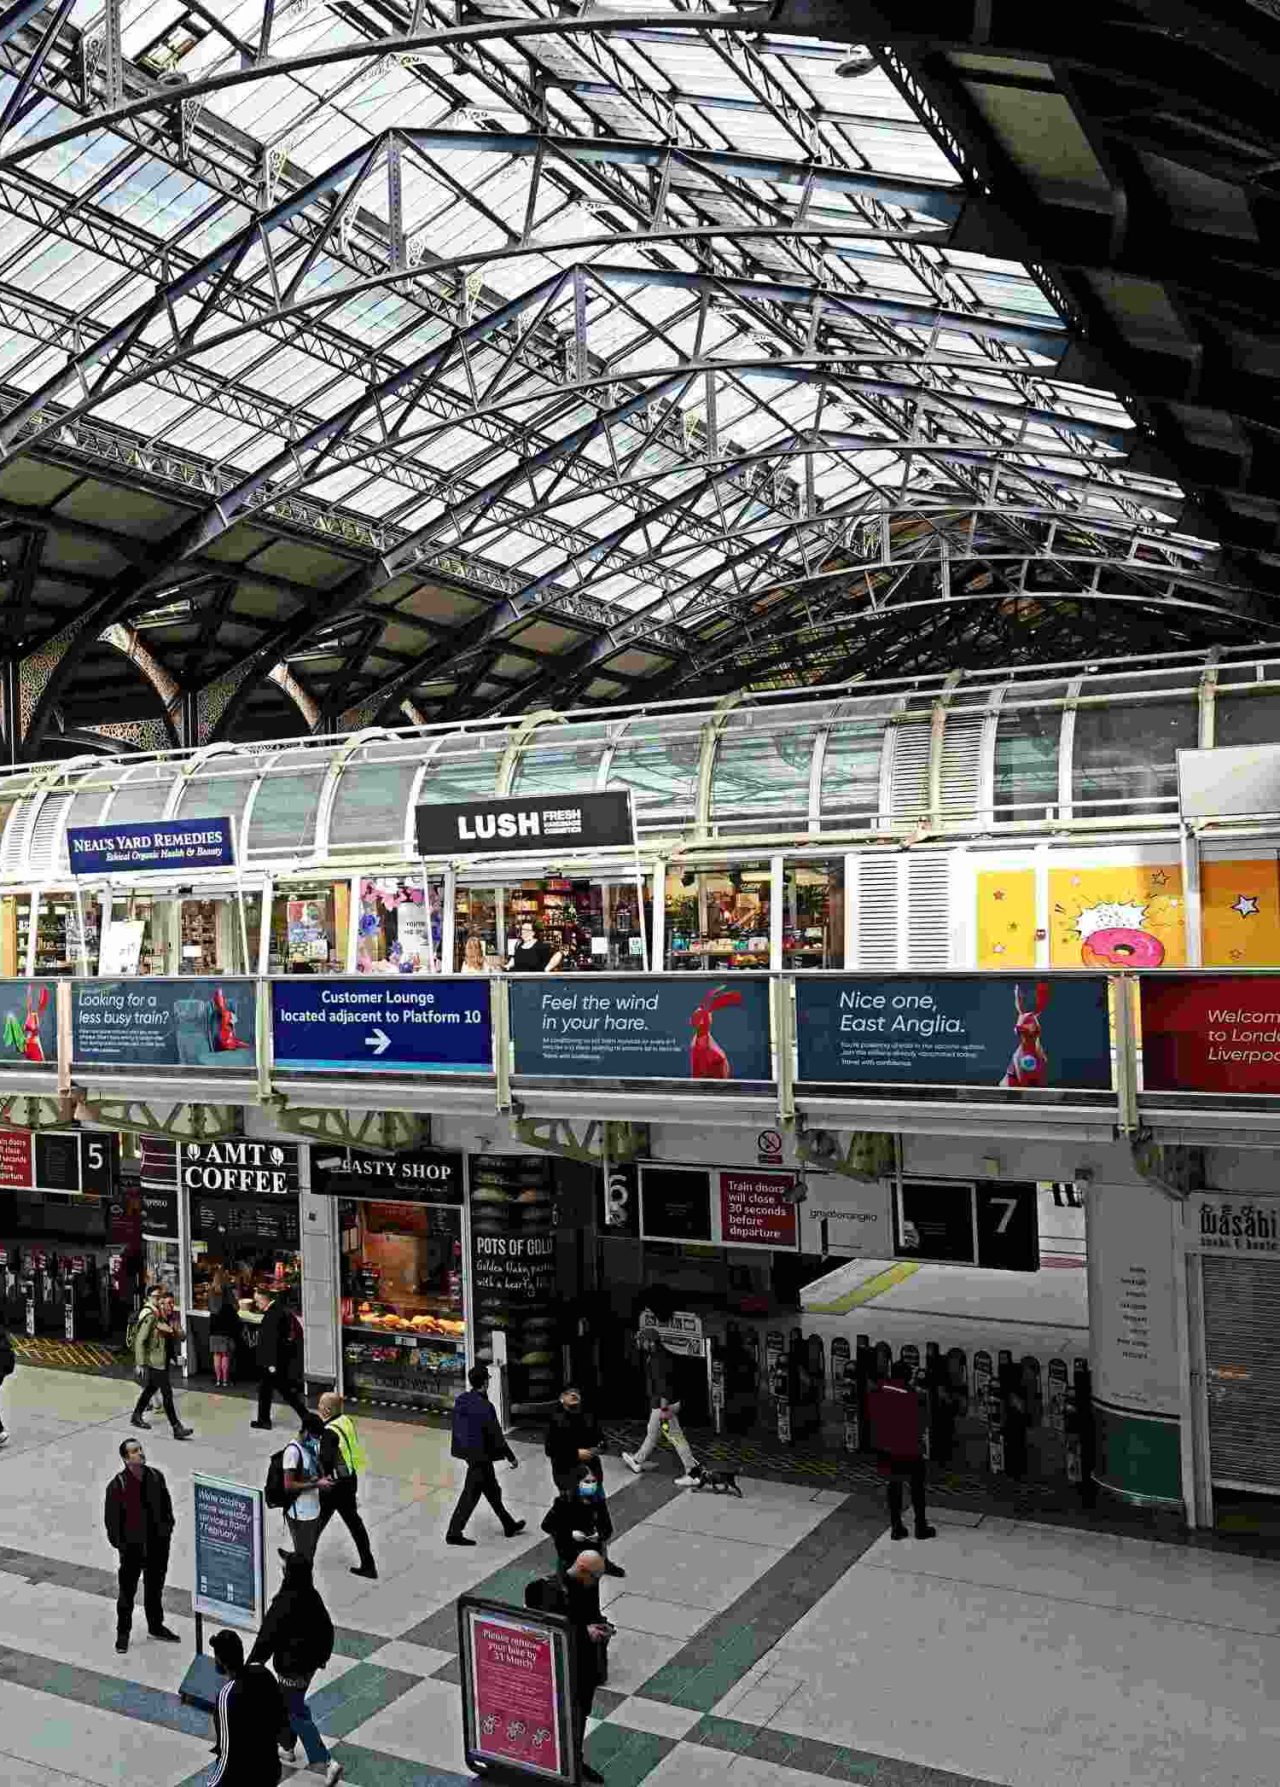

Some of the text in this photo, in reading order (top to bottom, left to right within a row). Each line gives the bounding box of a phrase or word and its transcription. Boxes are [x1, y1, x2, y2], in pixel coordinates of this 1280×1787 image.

[543, 809, 581, 821] FRESH
[458, 812, 540, 840] LUSH
[73, 831, 223, 852] NEAL'S YARD REMEDIES
[79, 991, 157, 1009] Looking for a
[321, 990, 435, 1007] Customer Lounge
[541, 994, 659, 1011] Feel the wind
[839, 991, 937, 1012] Nice one,
[79, 1010, 170, 1027] less busy train?
[281, 1009, 481, 1024] located adjacent to Platform 10
[542, 1013, 649, 1034] in your hare.
[840, 1014, 966, 1037] East Anglia.
[1208, 1030, 1226, 1042] to
[88, 1143, 103, 1169] 5
[206, 1142, 266, 1166] AMT
[185, 1165, 288, 1194] COFFEE
[402, 1162, 452, 1180] SHOP
[728, 1180, 785, 1194] Train doors
[728, 1193, 775, 1204] will close
[729, 1203, 787, 1216] 30 seconds
[989, 1199, 1018, 1234] 7
[729, 1215, 764, 1226] before
[730, 1226, 782, 1239] departure
[476, 1236, 554, 1256] POTS OF GOLD
[218, 1494, 246, 1510] adding
[229, 1518, 247, 1531] from
[483, 1630, 510, 1644] Please
[494, 1650, 534, 1670] 31 March
[527, 1650, 537, 1662] by
